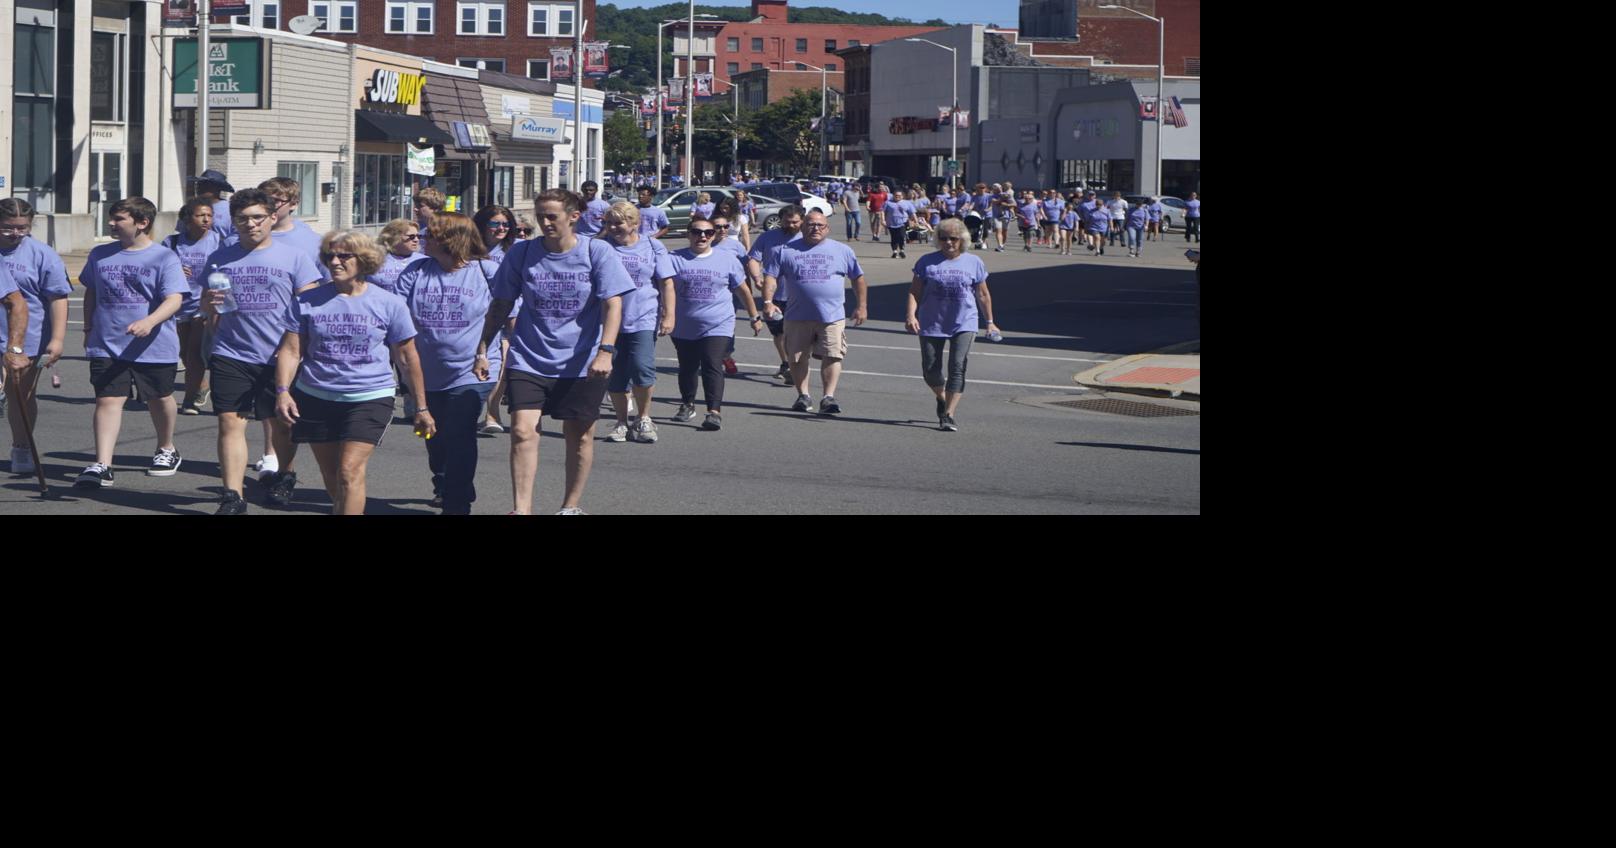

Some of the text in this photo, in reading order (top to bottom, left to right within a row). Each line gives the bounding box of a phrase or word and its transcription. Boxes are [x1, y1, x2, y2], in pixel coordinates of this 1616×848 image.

[370, 69, 427, 106] SUBWAY
[521, 123, 557, 135] Murray
[16, 263, 26, 272] US
[140, 267, 151, 277] US
[246, 266, 269, 275] WITH
[270, 268, 283, 278] US
[233, 276, 269, 285] TOGETHER
[552, 271, 576, 281] WITH
[441, 285, 460, 294] WITH
[462, 287, 475, 297] US
[538, 281, 576, 291] TOGETHER
[427, 294, 460, 304] TOGETHER
[535, 299, 580, 310] RECOVER
[311, 313, 340, 325] WALK
[342, 313, 368, 324] WITH
[421, 311, 463, 321] RECOVER
[325, 323, 368, 336] TOGETHER
[320, 343, 369, 355] RECOVER
